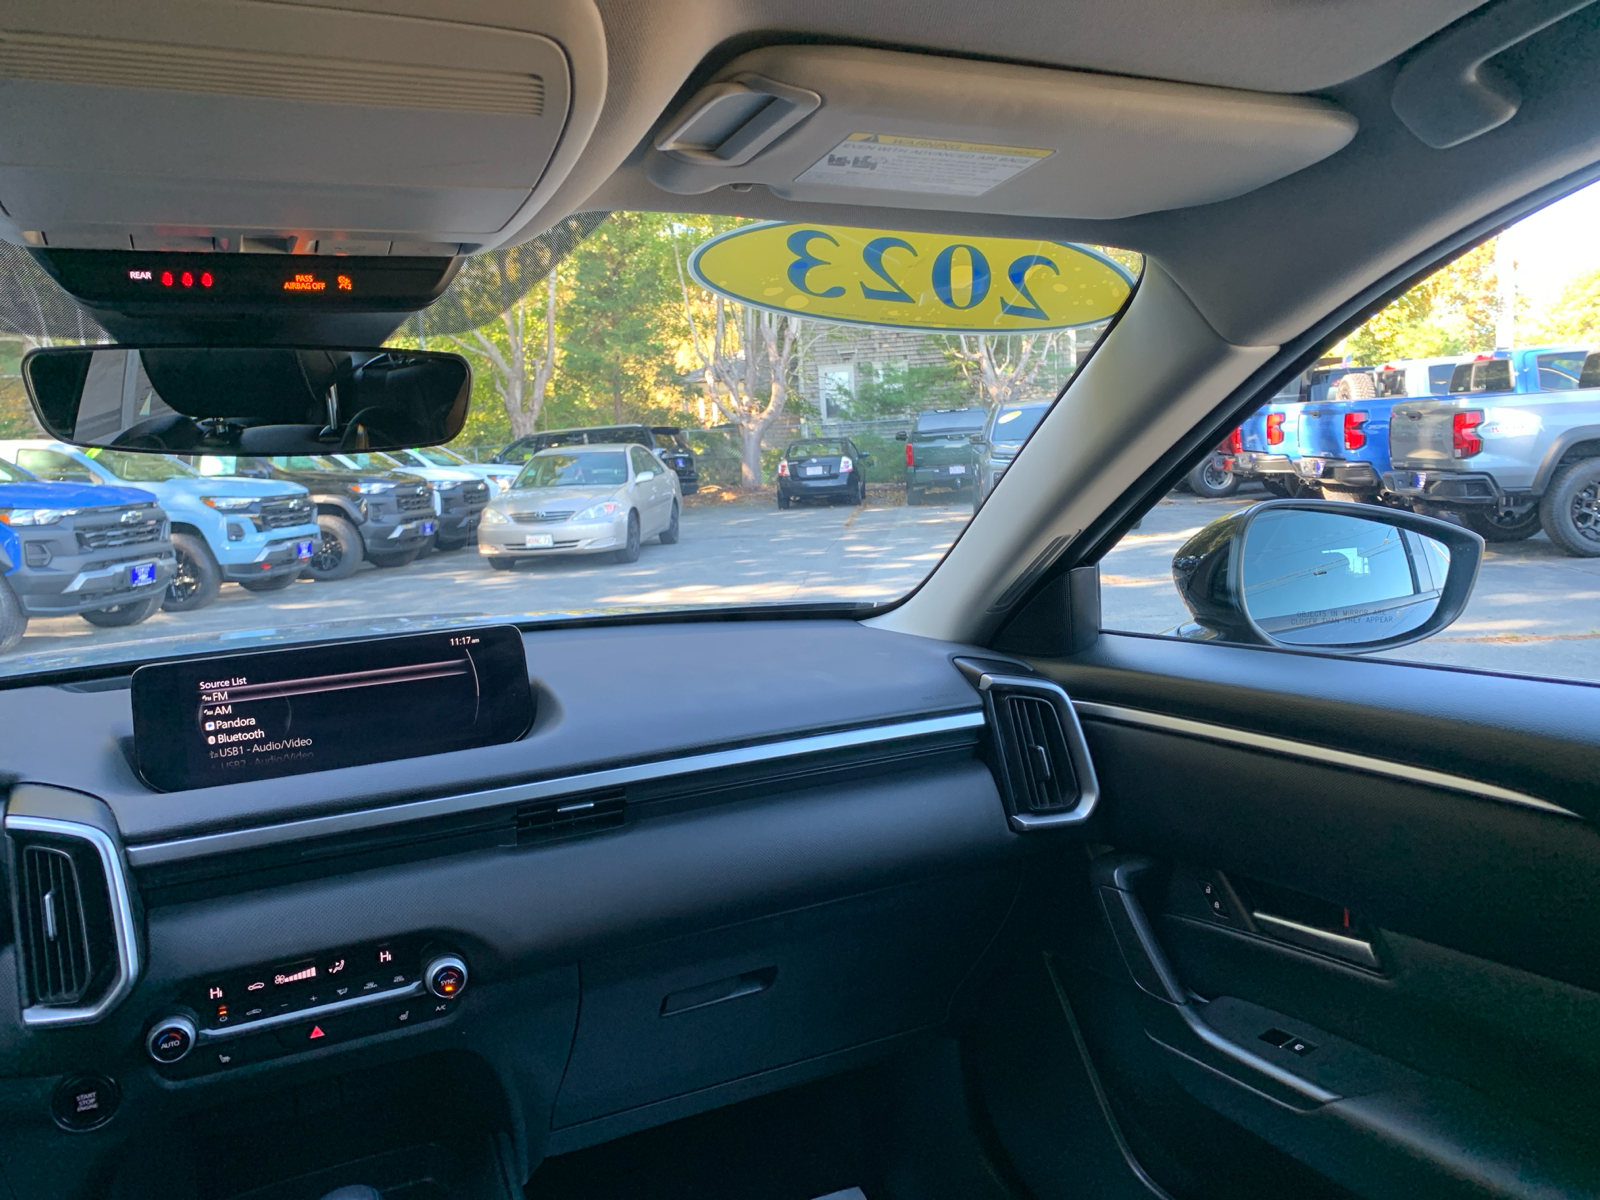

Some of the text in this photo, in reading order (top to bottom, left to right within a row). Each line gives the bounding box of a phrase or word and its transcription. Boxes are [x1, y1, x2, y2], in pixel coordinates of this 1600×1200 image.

[893, 138, 962, 150] WARNING
[842, 143, 875, 151] EVEN
[878, 146, 908, 154] WITH
[908, 149, 975, 160] ADVANCED
[999, 156, 1032, 164] BAGS
[130, 271, 152, 280] REAR
[295, 274, 314, 282] PASS
[284, 281, 326, 290] AIRBAG OFF
[1296, 610, 1327, 618] OBJECTS
[1290, 615, 1393, 626] CLOSER THAN THEY APPEAR
[199, 677, 247, 690] Source List
[212, 691, 228, 702] FM
[214, 705, 232, 716] AM
[216, 717, 256, 730] Pandora
[217, 728, 265, 744] Bluetooth
[219, 746, 244, 758] USB1
[252, 738, 313, 753] Audio/Video
[440, 978, 456, 987] SYNC
[435, 1004, 447, 1012] A/C
[161, 1040, 180, 1050] AUTO
[76, 1091, 96, 1101] START
[78, 1098, 96, 1107] STOP
